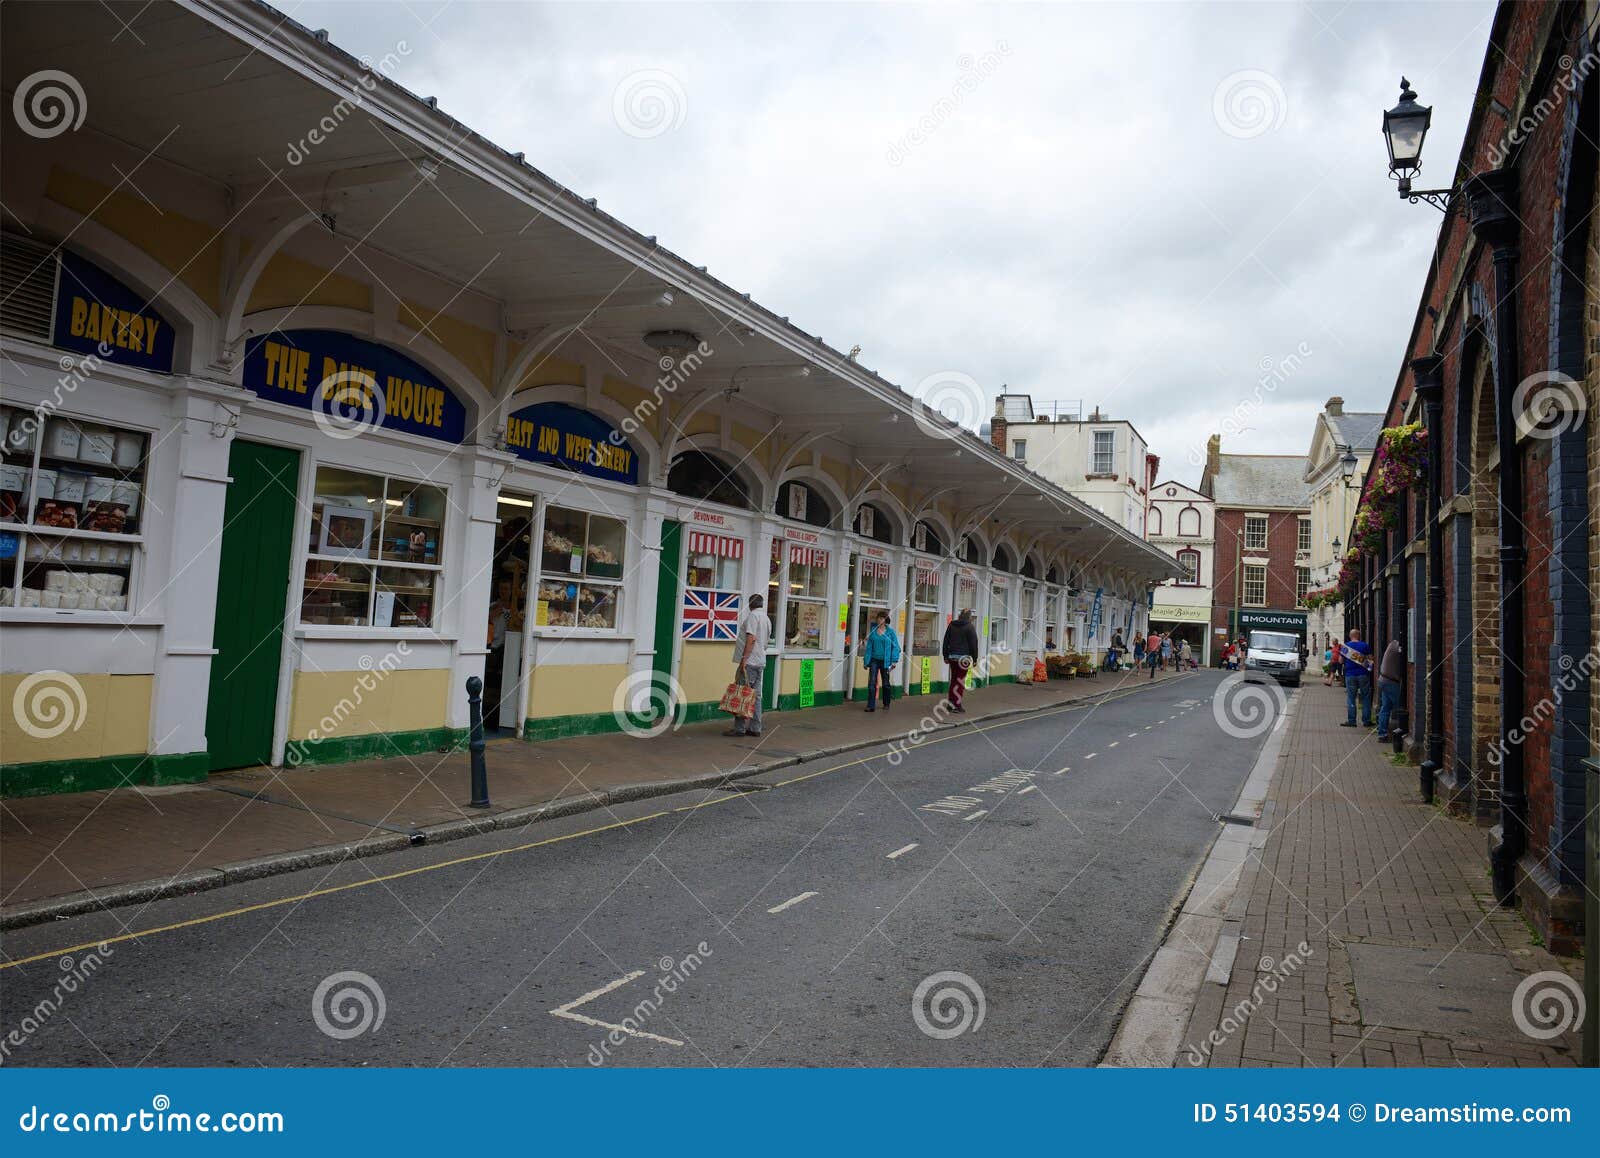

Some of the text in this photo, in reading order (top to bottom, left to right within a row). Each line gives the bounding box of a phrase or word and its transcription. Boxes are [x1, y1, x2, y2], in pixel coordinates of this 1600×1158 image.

[70, 296, 160, 354] BAKERY
[265, 341, 445, 428] THE BAKE HOUSE
[507, 417, 632, 474] EAST AND WEST BAKERY
[1249, 615, 1303, 625] MOUNTAIN
